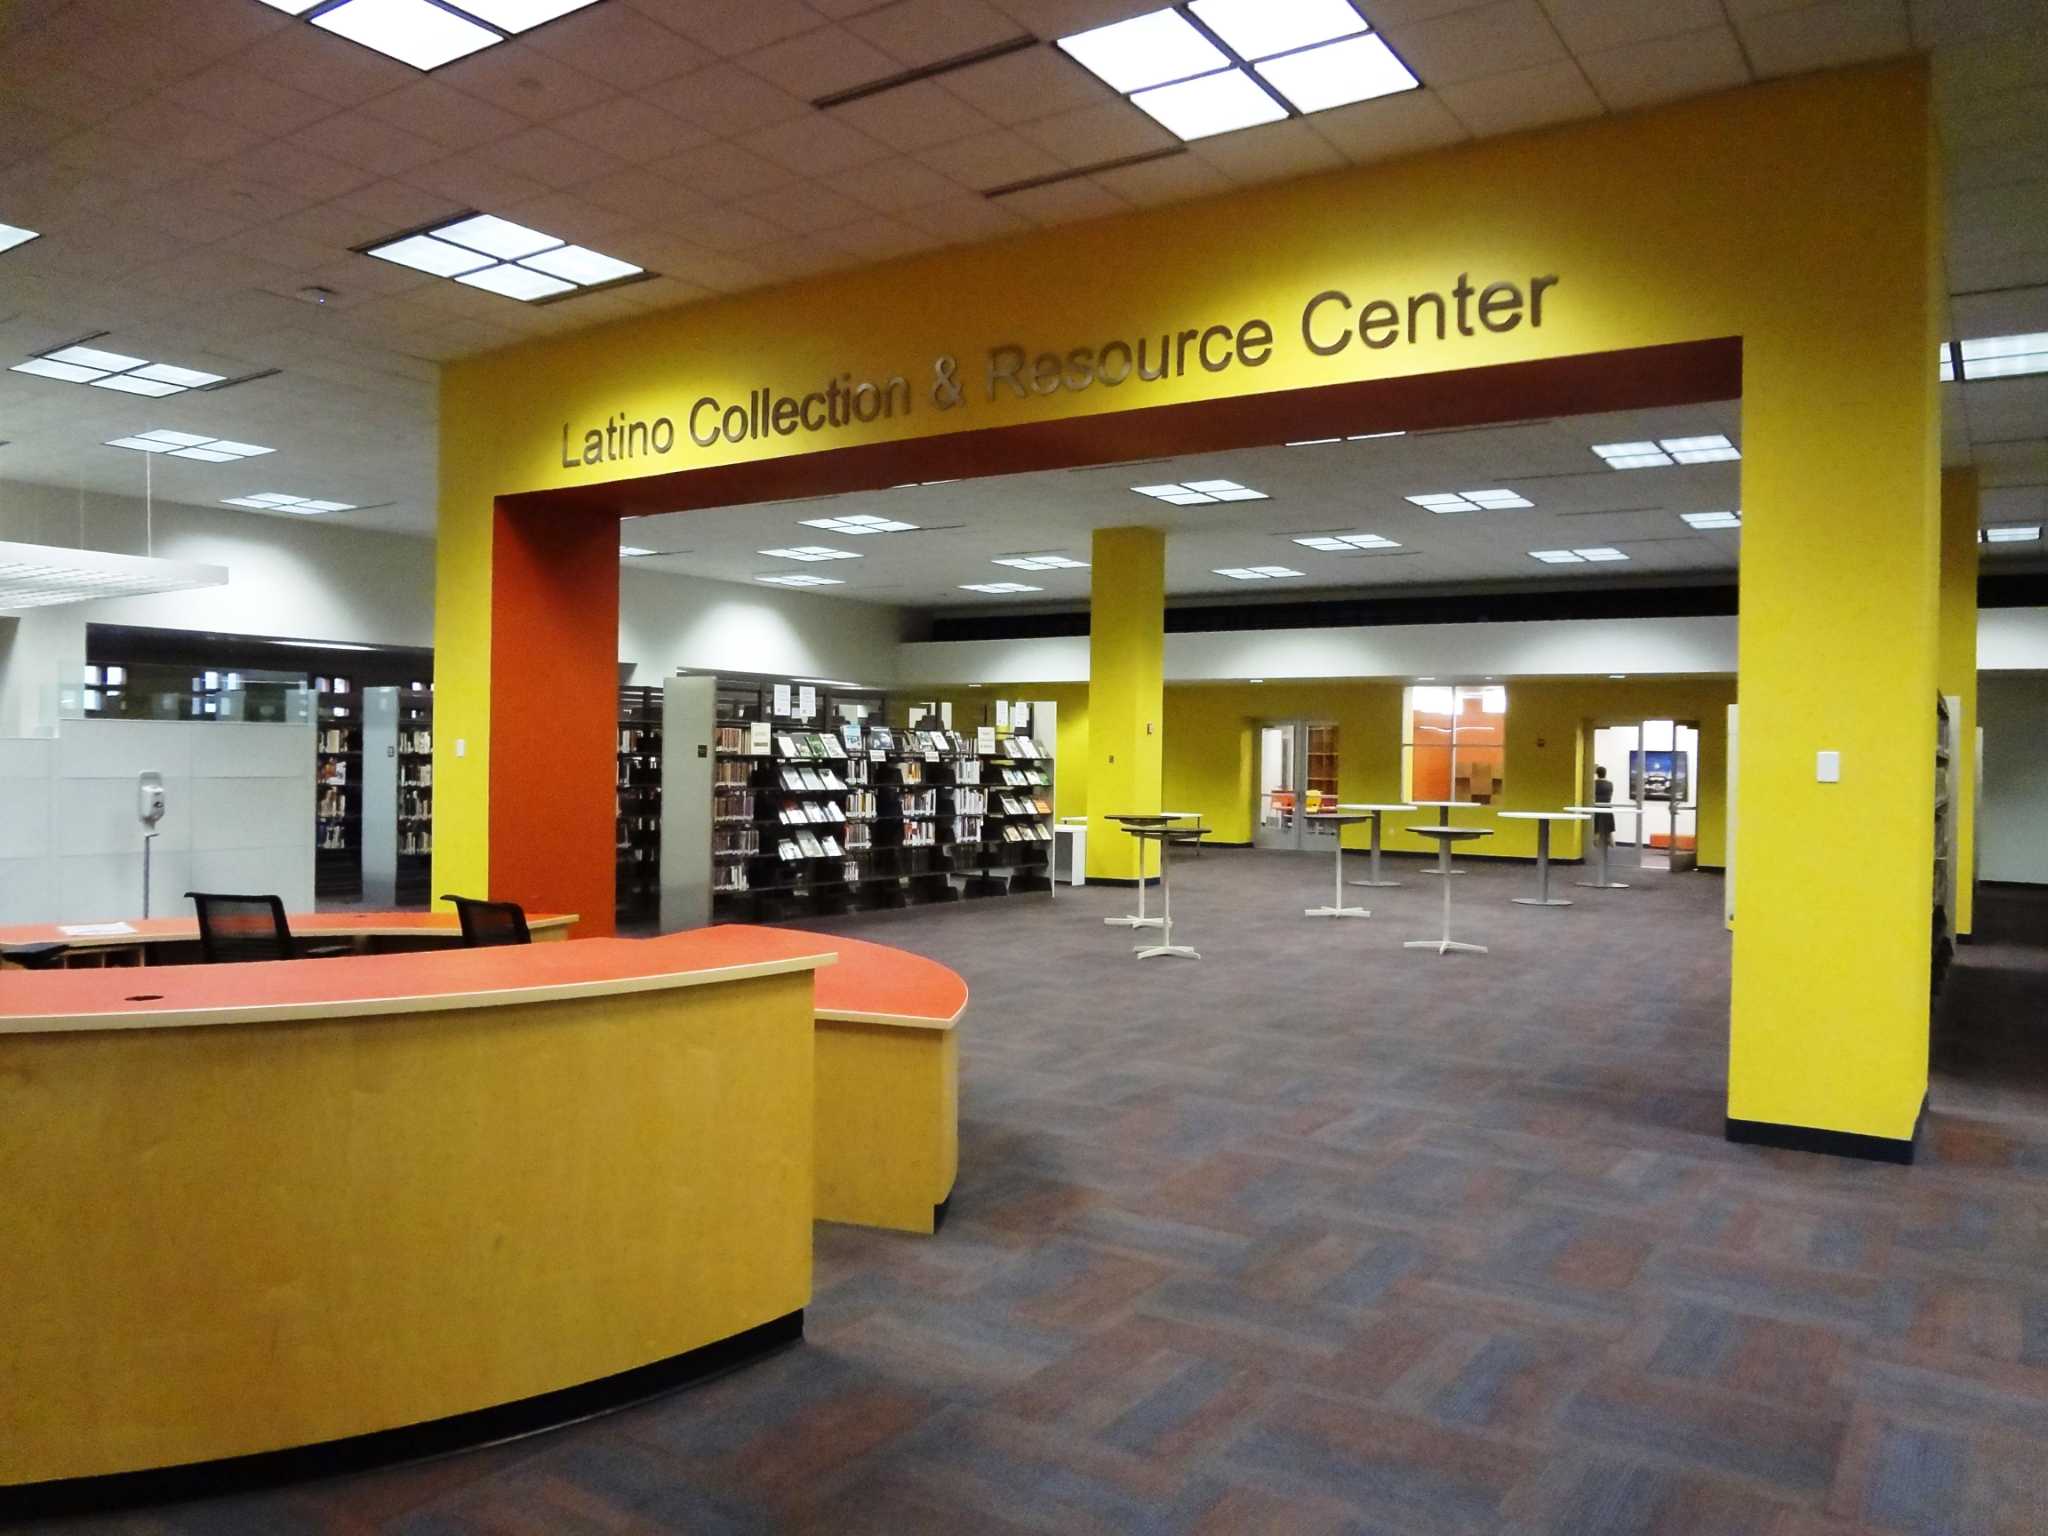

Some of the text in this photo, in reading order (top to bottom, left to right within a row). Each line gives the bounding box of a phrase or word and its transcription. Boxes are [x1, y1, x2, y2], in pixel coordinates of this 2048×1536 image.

[561, 271, 1558, 468] Latino Collection & Resource Center
